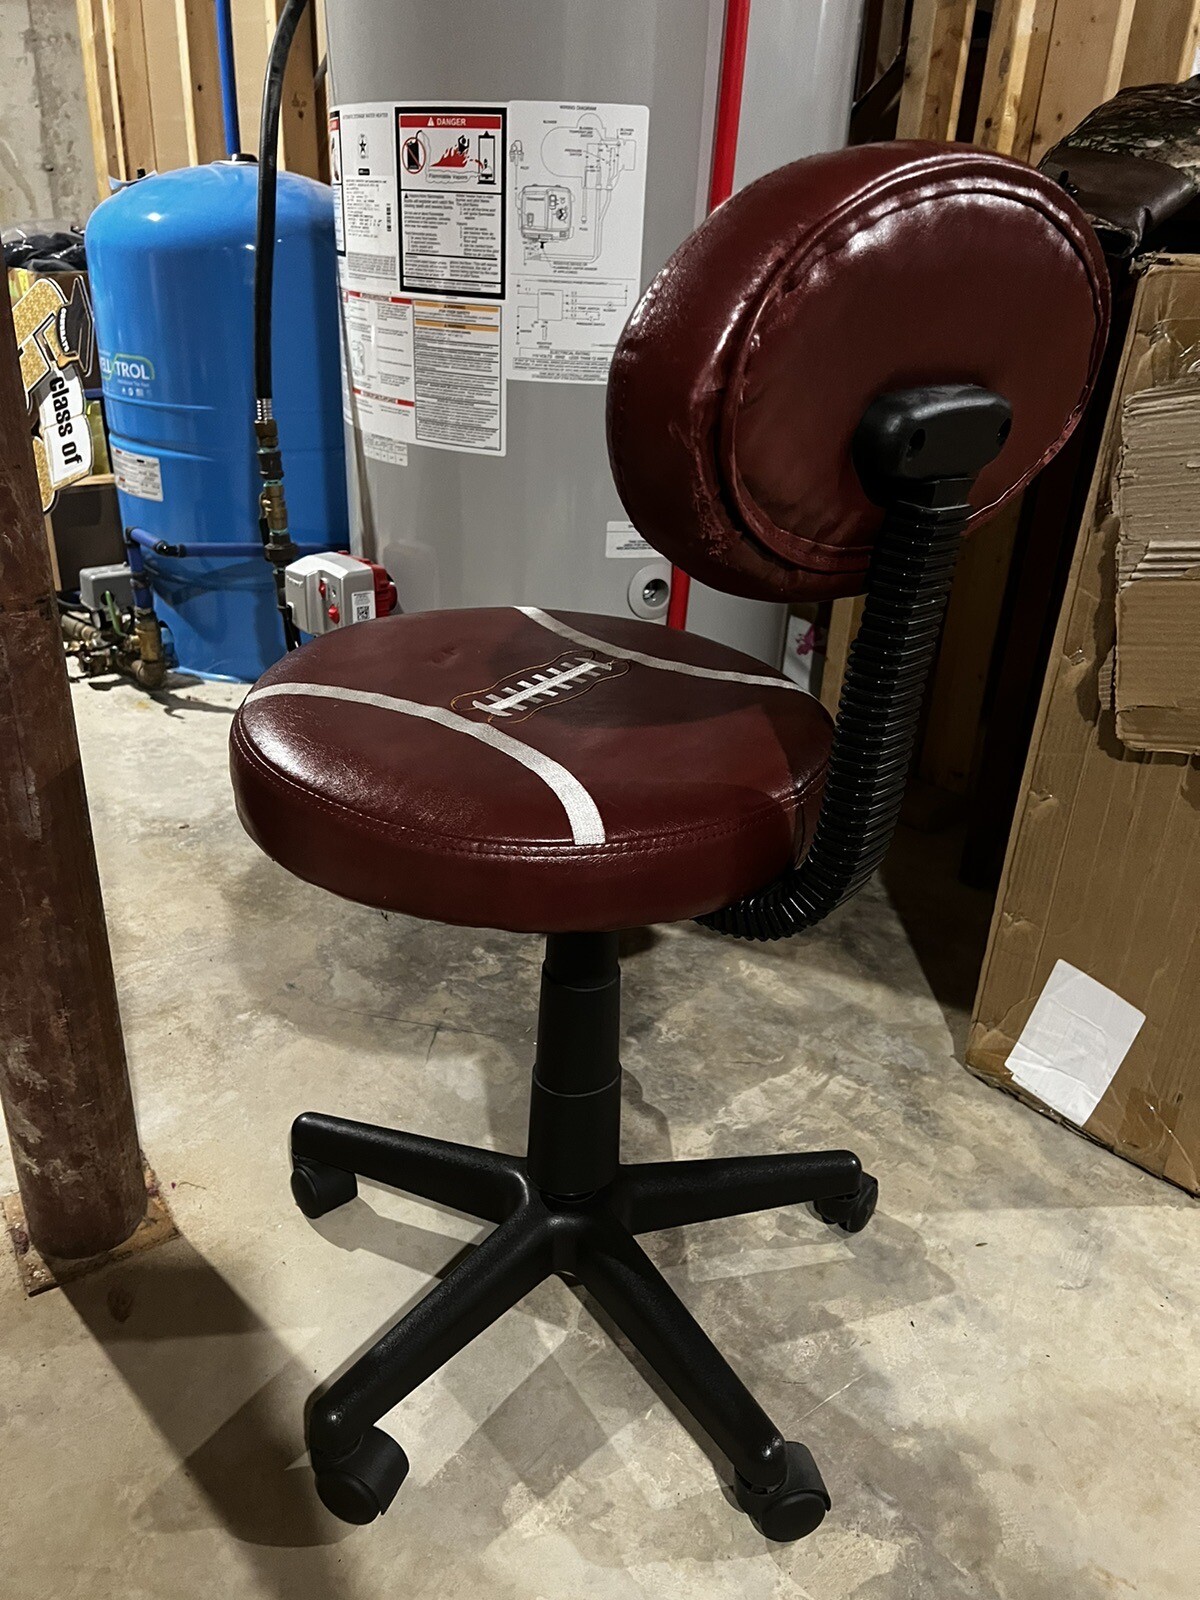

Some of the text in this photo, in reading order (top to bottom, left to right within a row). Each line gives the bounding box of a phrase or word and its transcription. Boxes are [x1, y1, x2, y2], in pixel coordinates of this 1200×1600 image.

[436, 118, 467, 126] DANGER
[114, 361, 150, 380] TROL
[50, 377, 83, 465] class of
